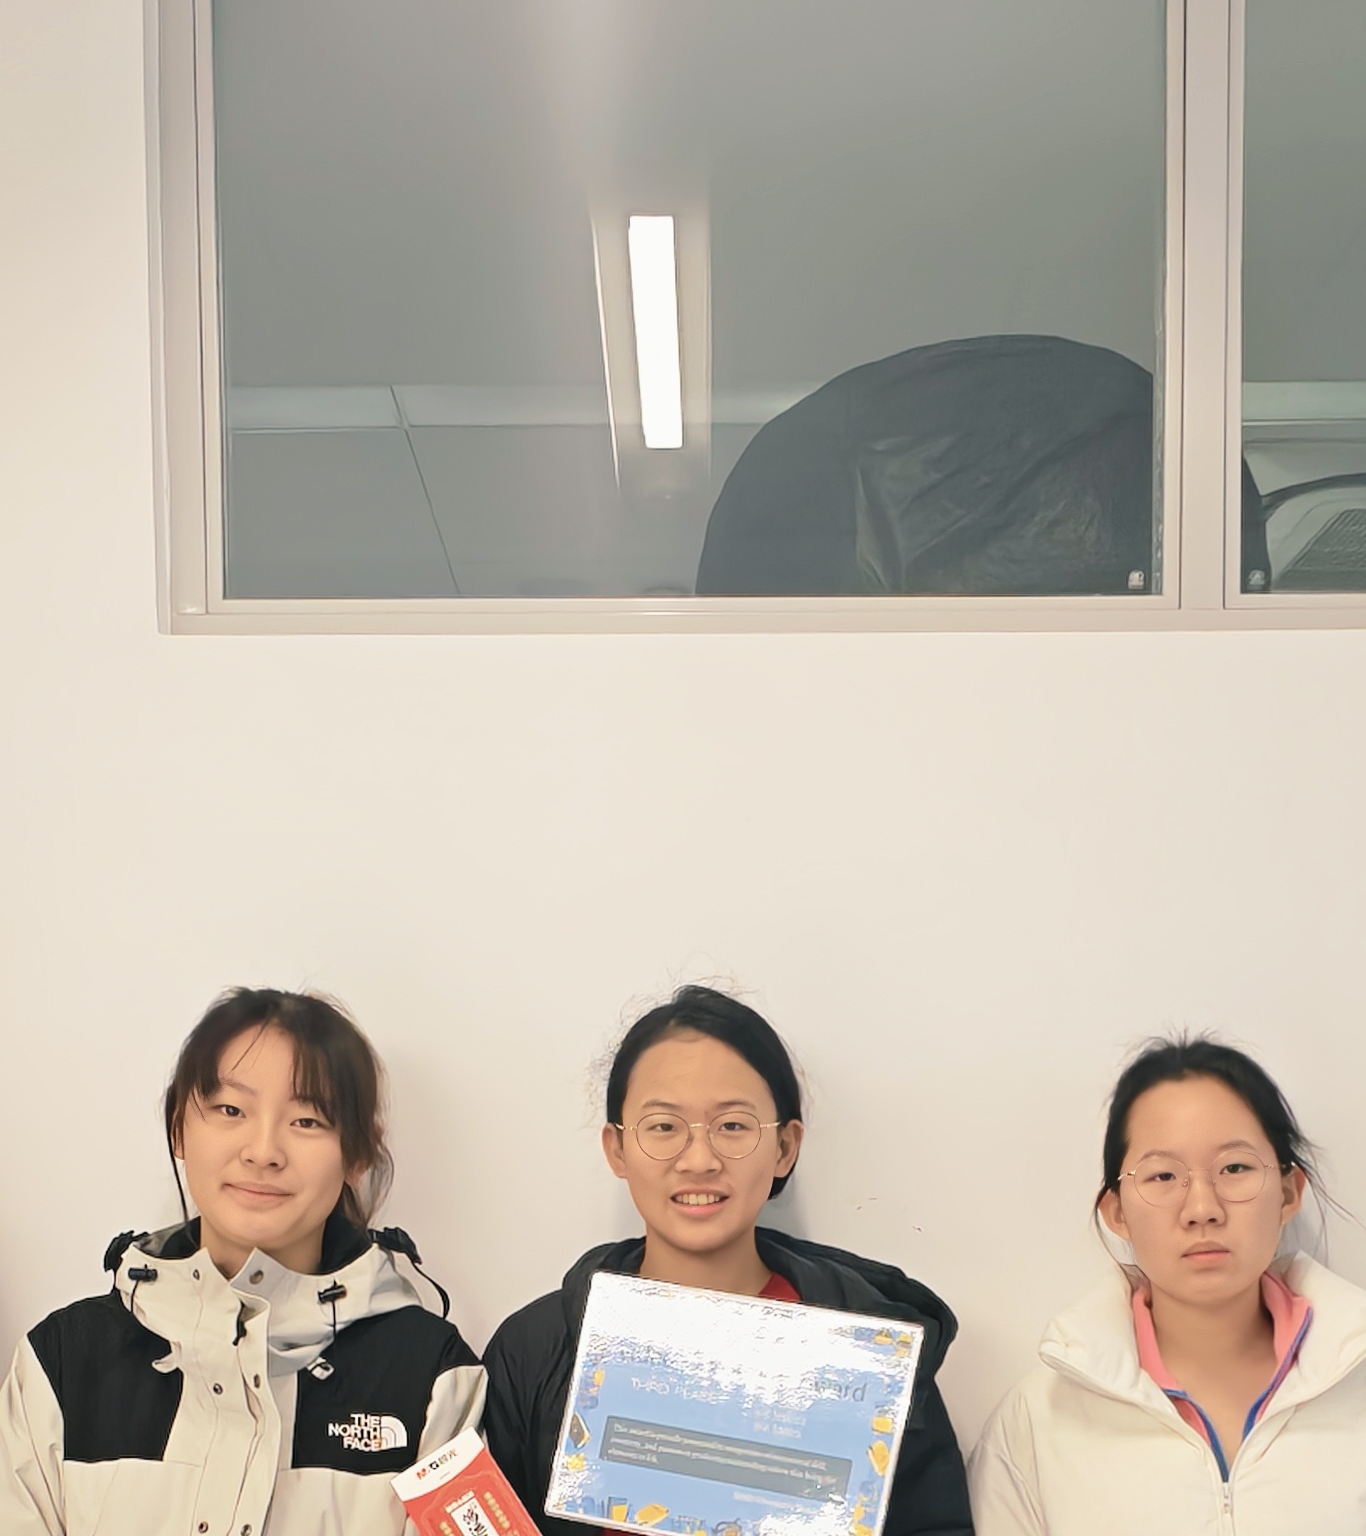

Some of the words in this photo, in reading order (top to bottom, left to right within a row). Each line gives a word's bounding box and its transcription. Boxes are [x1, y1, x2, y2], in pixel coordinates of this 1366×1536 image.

[349, 1413, 381, 1428] THE
[327, 1422, 381, 1440] NORTH
[343, 1436, 382, 1452] FACE
